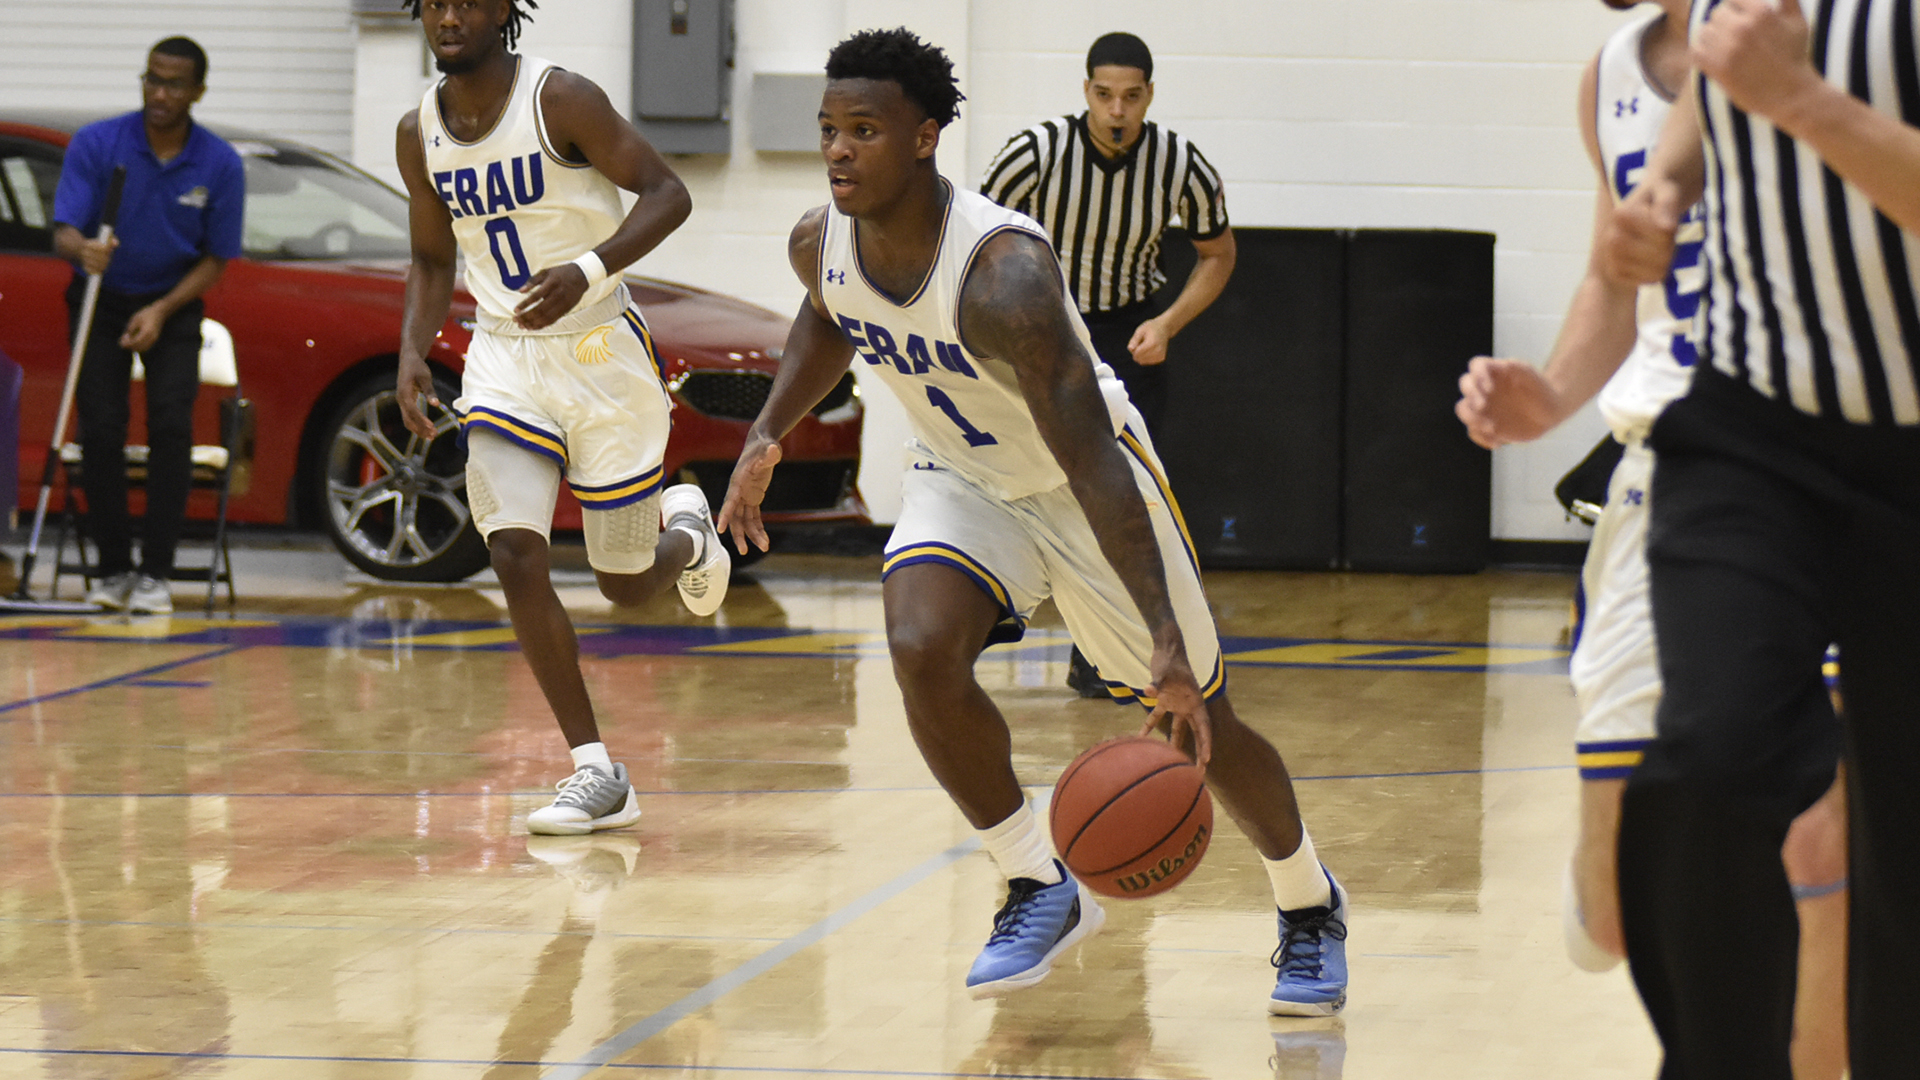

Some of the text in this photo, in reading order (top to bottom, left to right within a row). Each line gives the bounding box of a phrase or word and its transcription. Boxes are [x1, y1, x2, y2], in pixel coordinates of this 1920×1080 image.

[433, 152, 545, 218] ERAU
[484, 216, 531, 291] 0
[836, 312, 979, 380] ERAU
[925, 385, 998, 447] 1
[1117, 824, 1207, 892] Wilson
